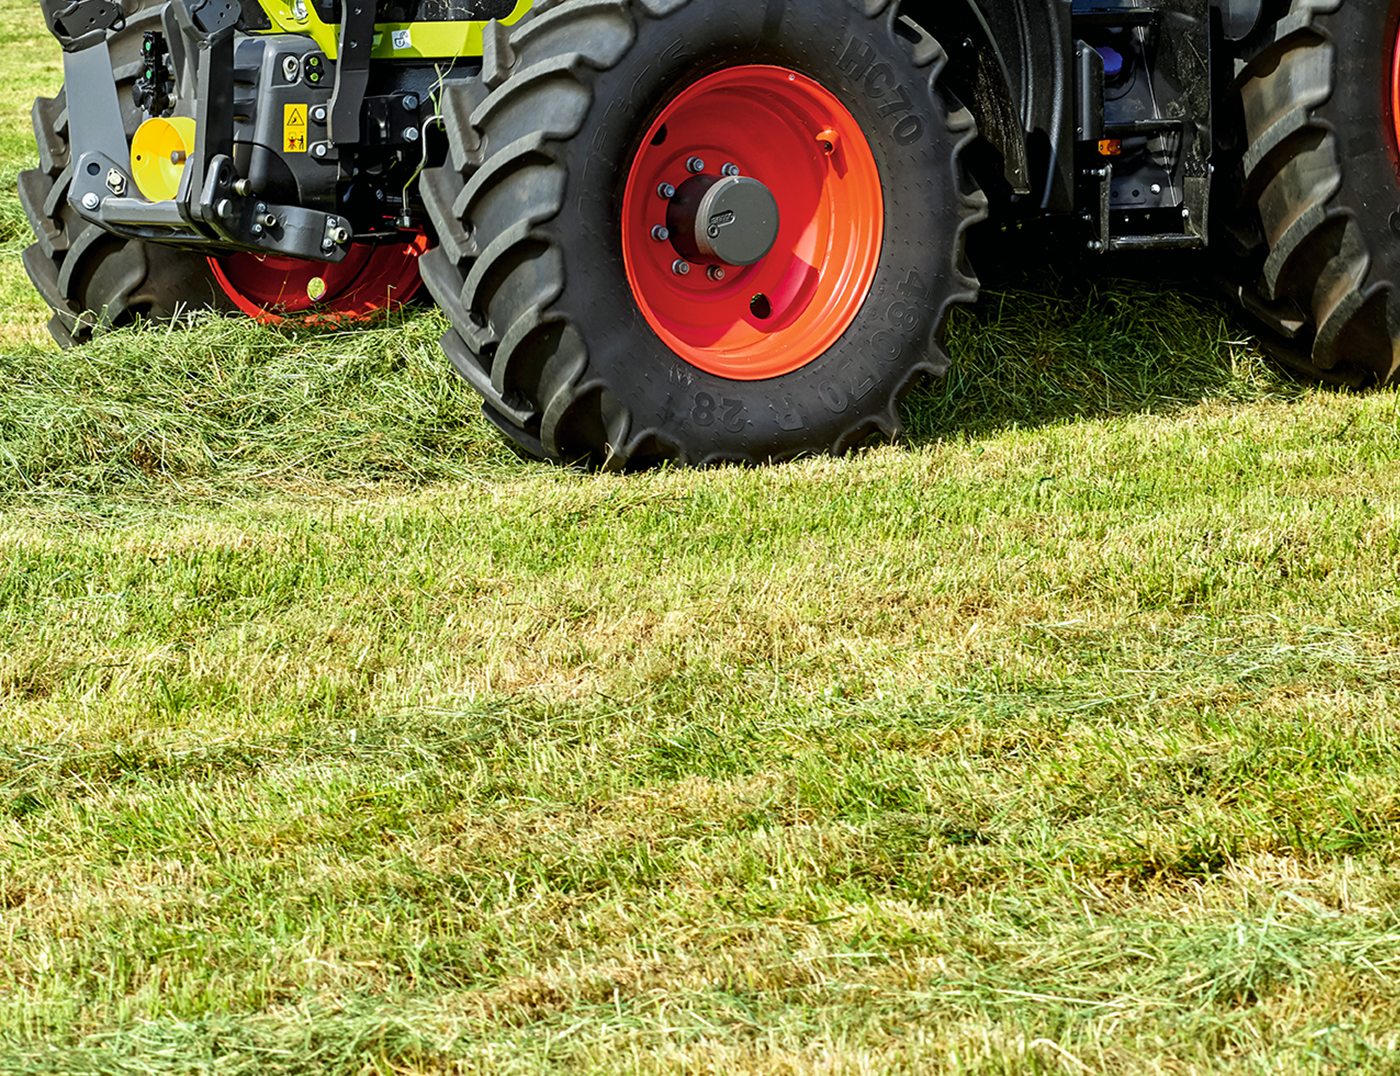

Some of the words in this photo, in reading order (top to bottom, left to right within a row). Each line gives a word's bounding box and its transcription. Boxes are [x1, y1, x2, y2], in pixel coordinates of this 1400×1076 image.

[836, 34, 924, 146] HC70
[690, 390, 747, 434] 28
[767, 394, 804, 431] R
